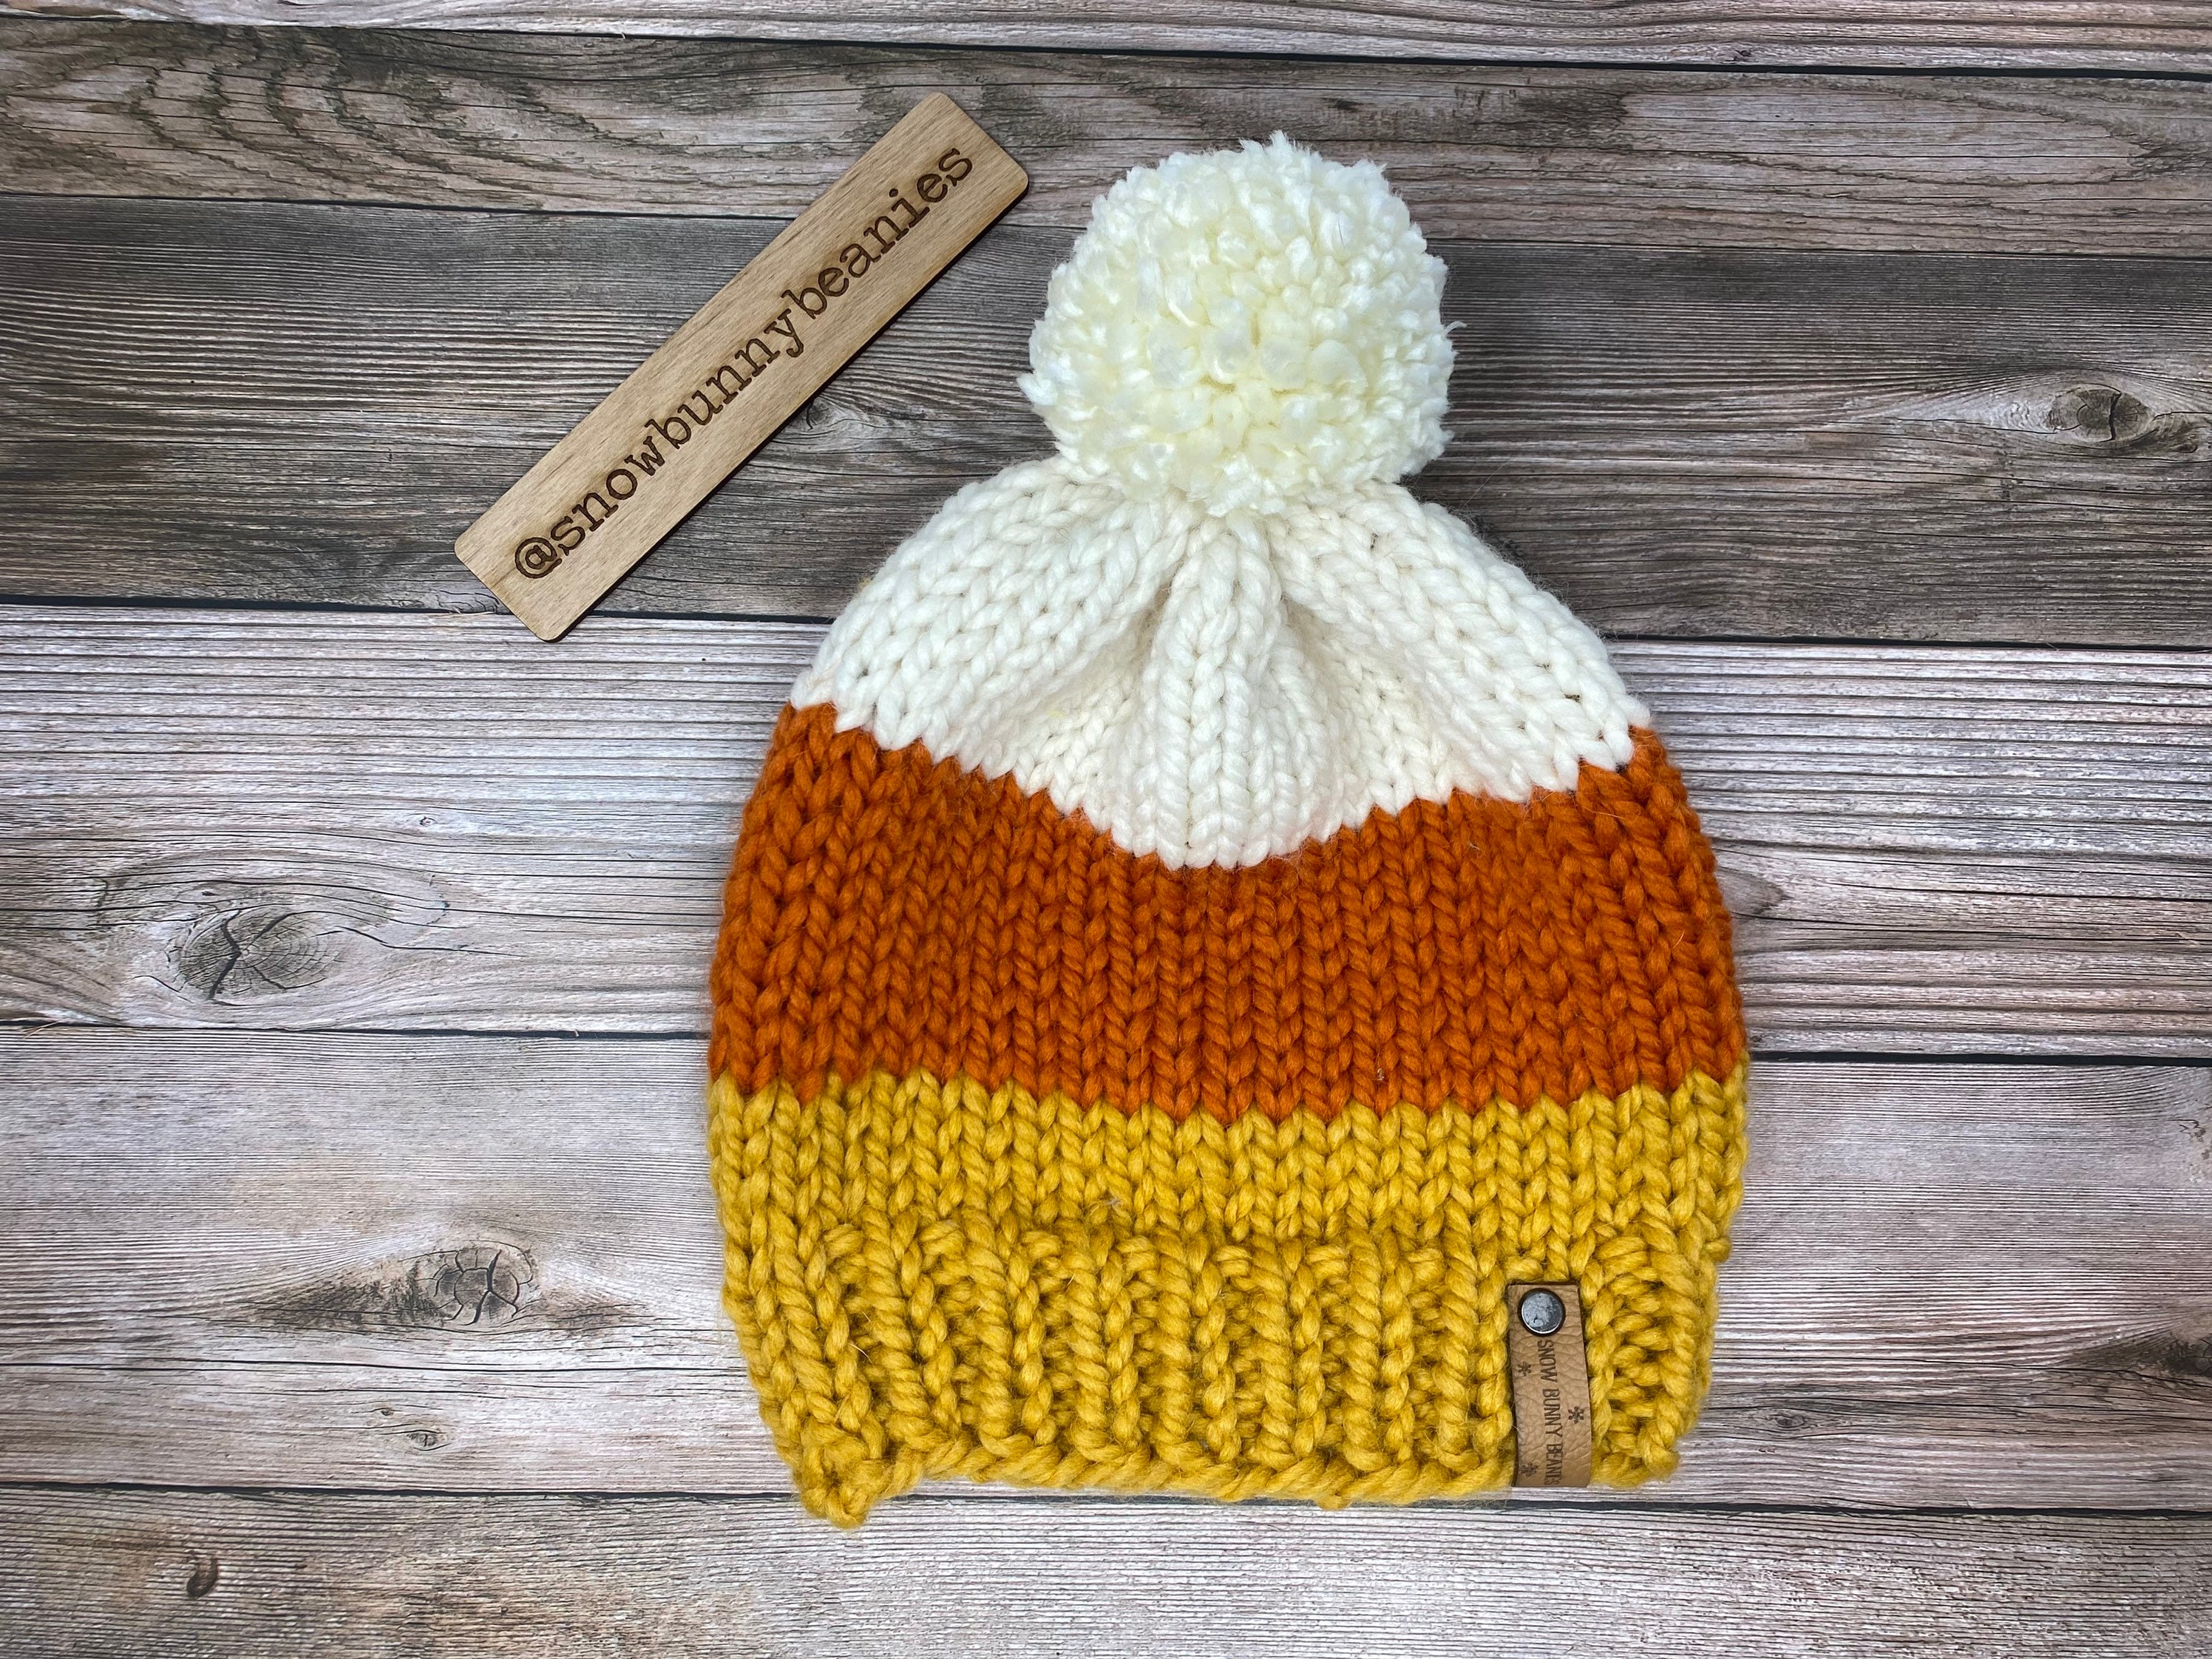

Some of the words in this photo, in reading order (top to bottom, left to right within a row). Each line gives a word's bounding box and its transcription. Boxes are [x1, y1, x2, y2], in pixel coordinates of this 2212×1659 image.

[514, 147, 973, 579] @snowbunnybeanies
[1538, 1340, 1558, 1382] SNOW
[1543, 1388, 1563, 1437] BUNNY
